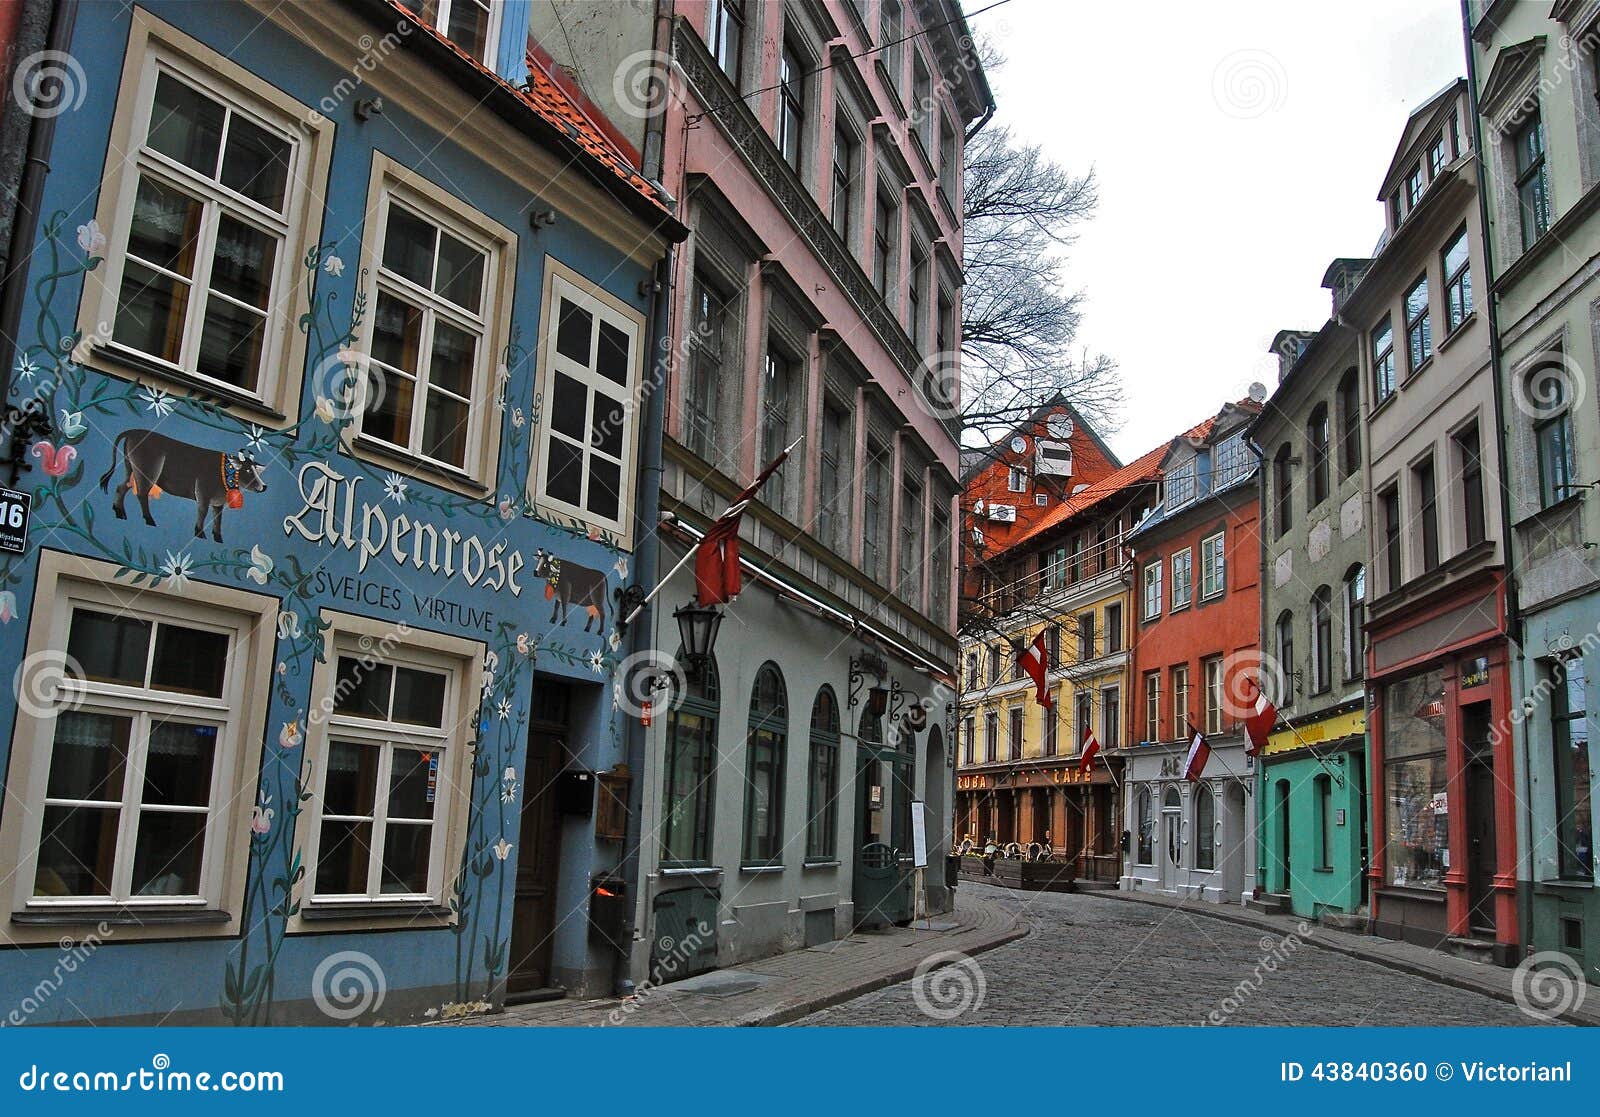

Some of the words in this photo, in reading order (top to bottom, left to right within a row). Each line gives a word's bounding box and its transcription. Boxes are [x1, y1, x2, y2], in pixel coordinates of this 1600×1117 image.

[0, 501, 24, 528] 16
[283, 461, 525, 597] Alpenrose
[315, 566, 401, 611] ŠVEICES
[958, 775, 987, 789] CUBA
